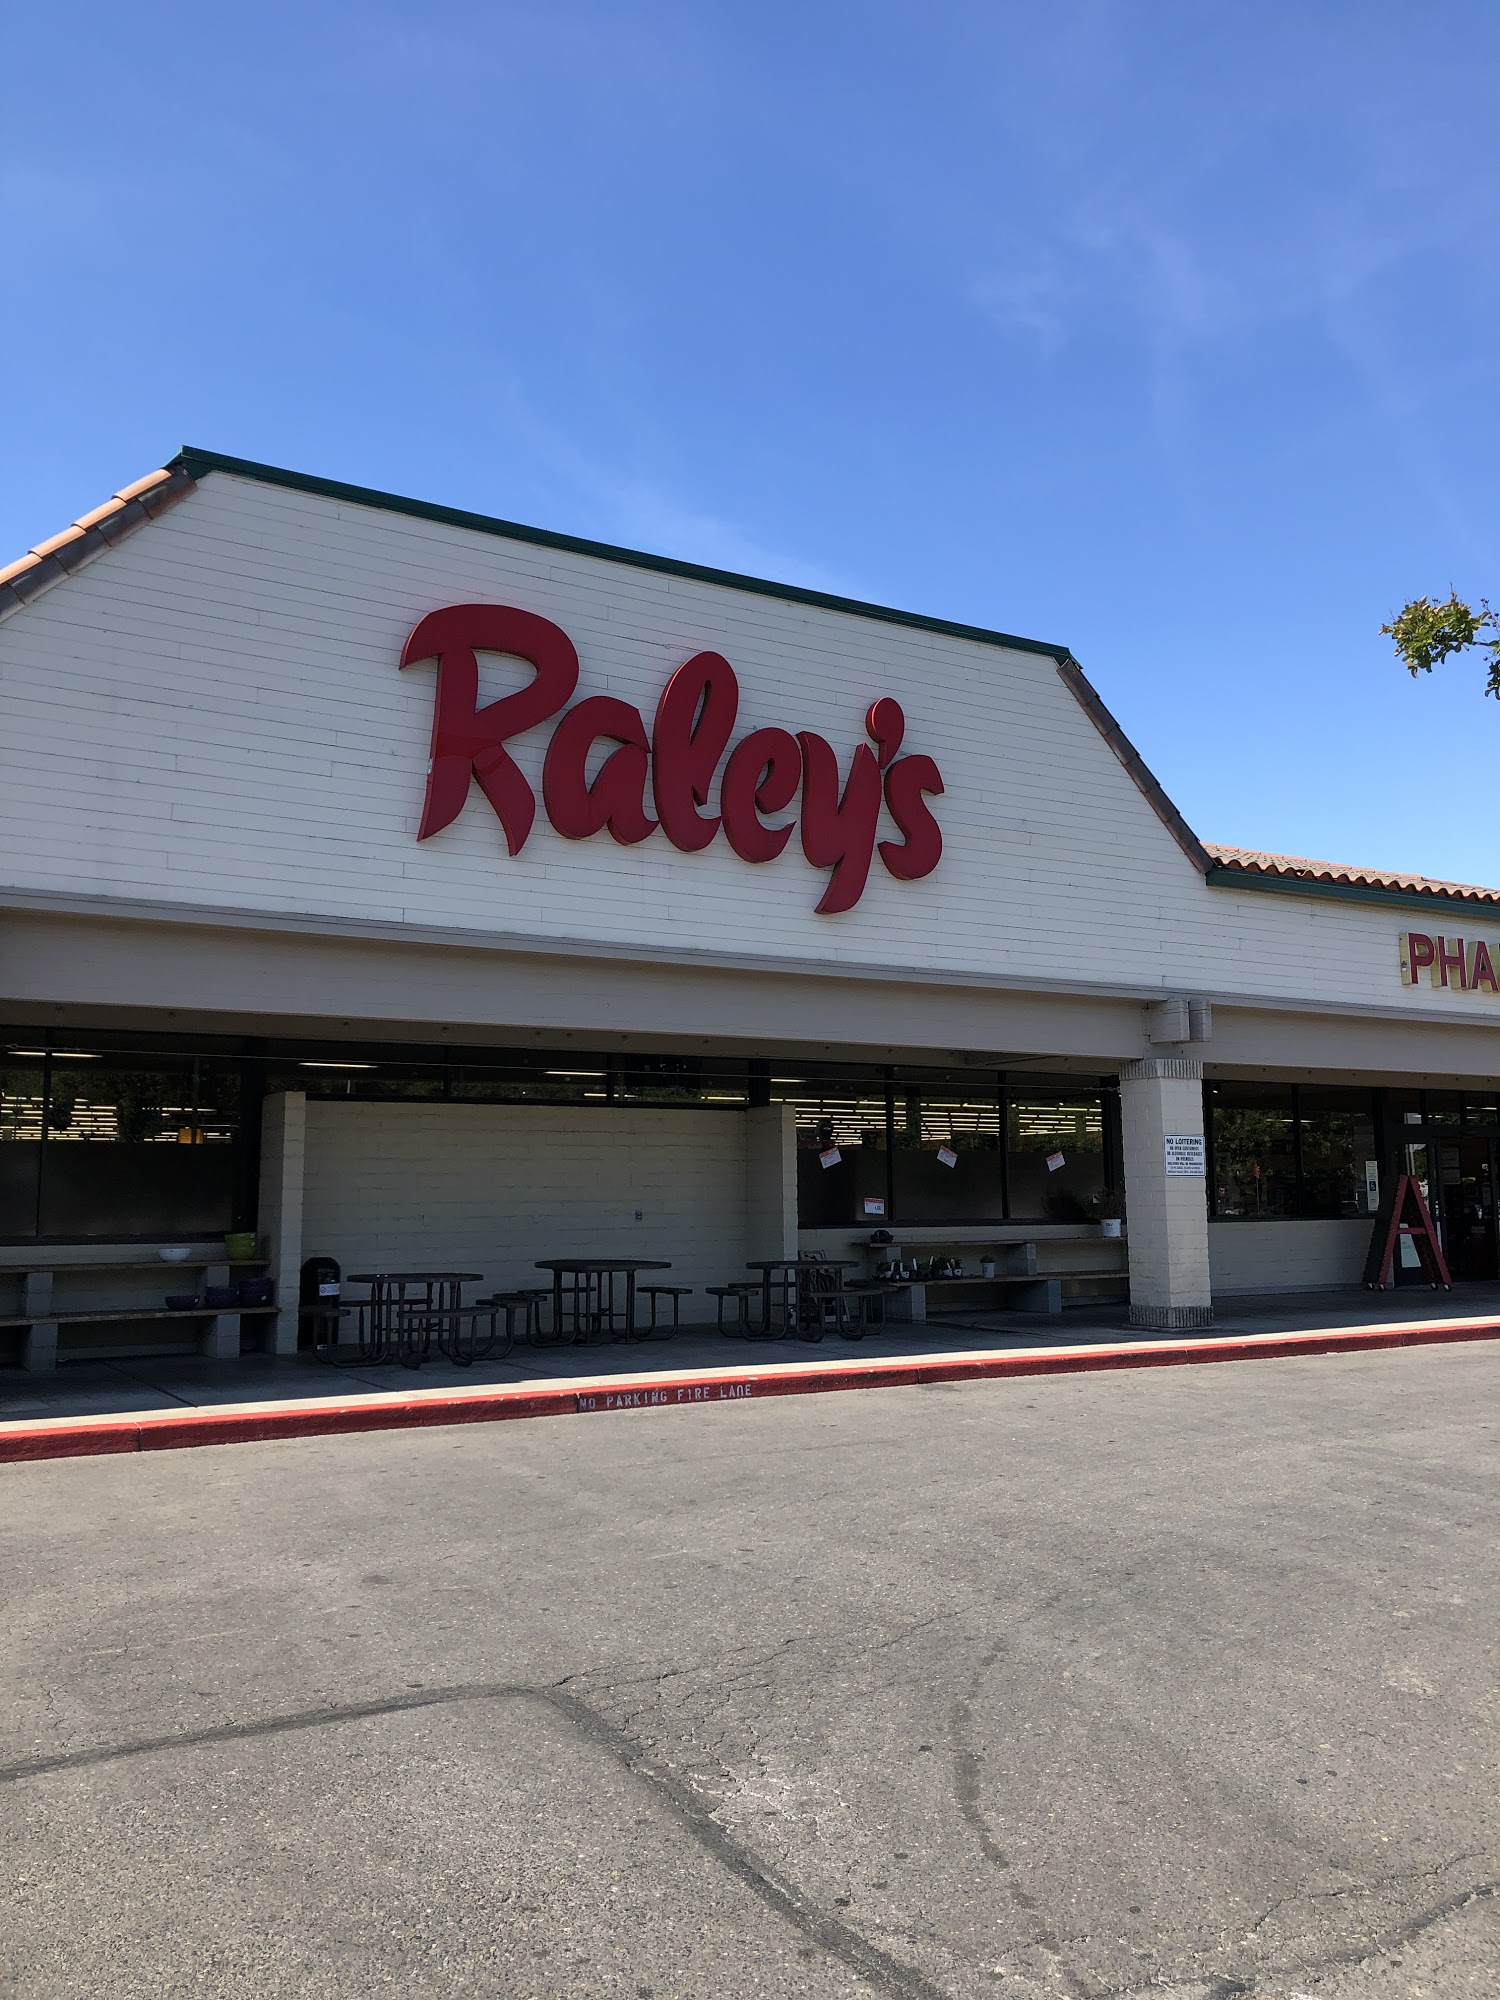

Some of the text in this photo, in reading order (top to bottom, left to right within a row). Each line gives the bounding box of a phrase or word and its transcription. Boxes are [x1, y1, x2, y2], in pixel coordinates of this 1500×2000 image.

[399, 603, 944, 914] Raley's
[1401, 932, 1500, 991] PHA
[579, 1384, 752, 1411] NO PARKING FIRE LANE
